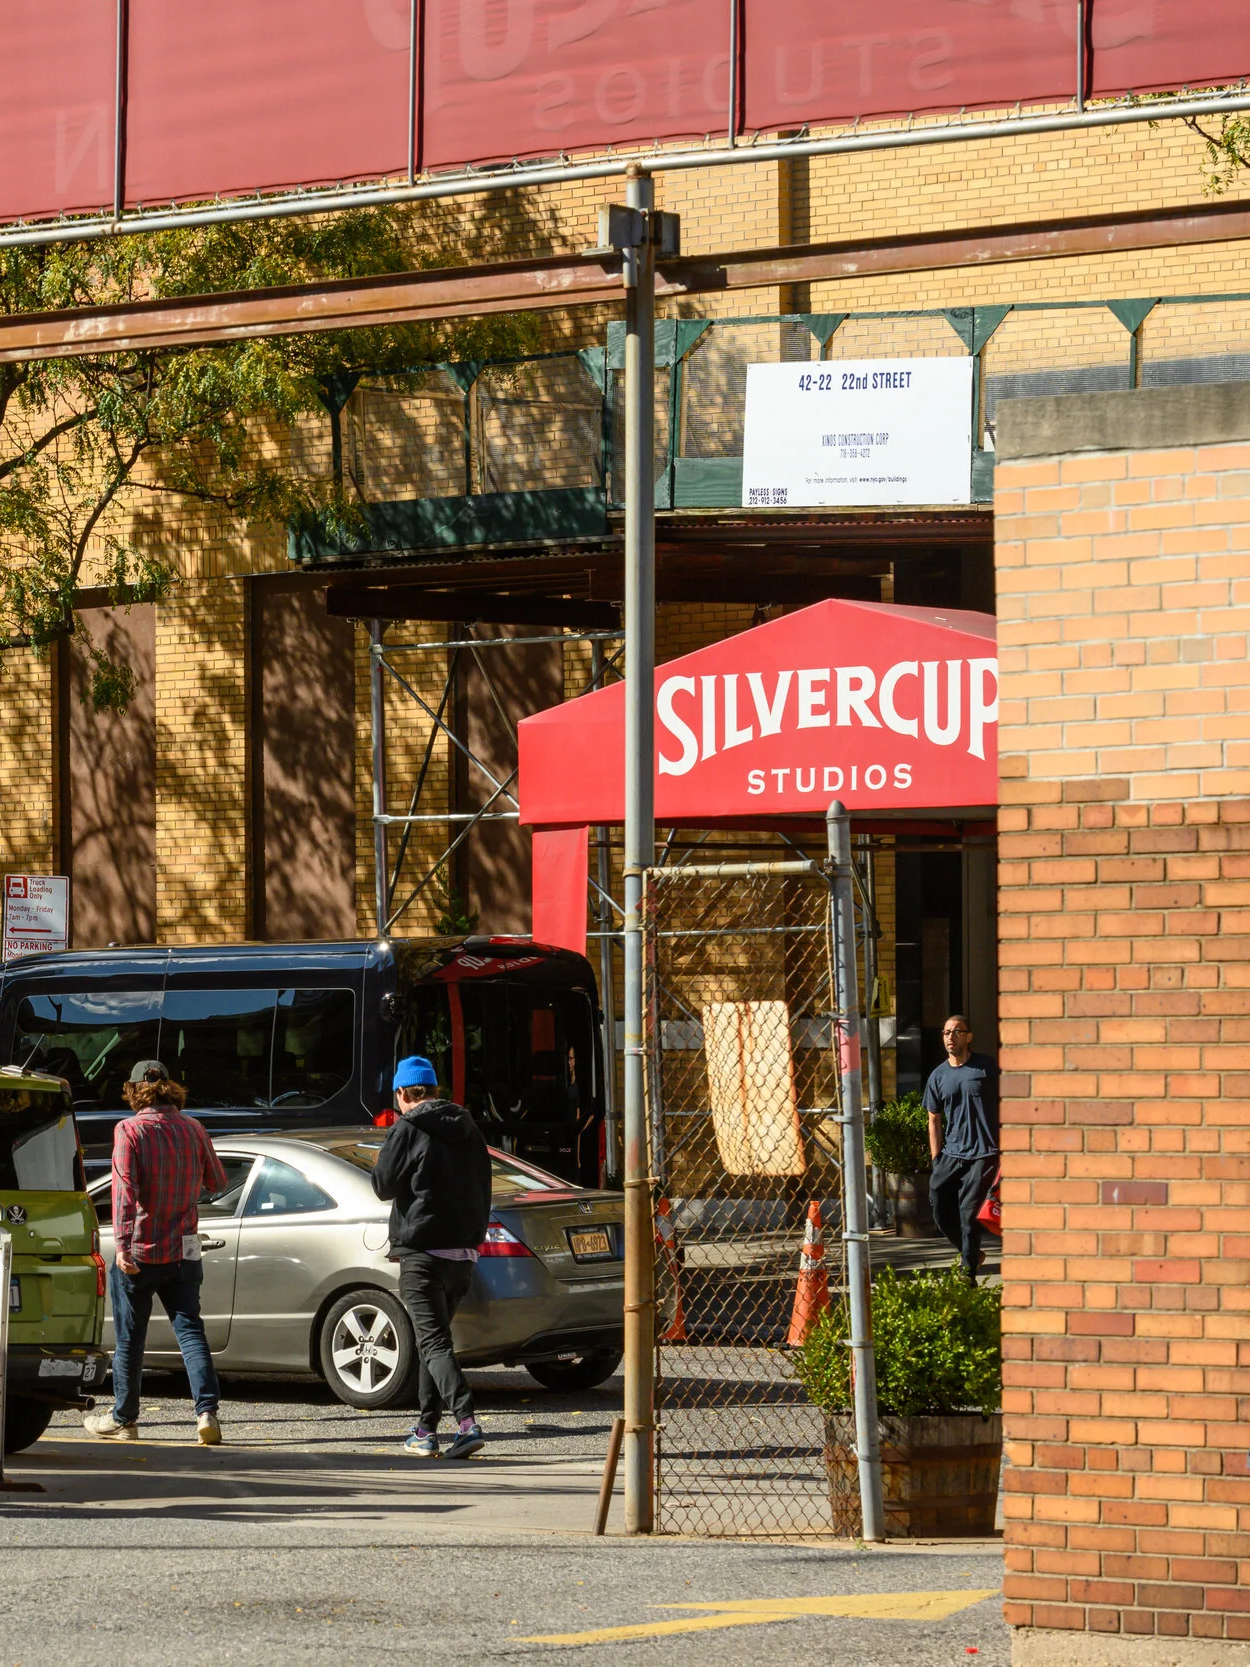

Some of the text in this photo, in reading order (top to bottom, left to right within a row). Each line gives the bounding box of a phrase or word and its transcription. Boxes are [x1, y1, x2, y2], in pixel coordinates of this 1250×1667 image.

[798, 372, 912, 391] 42-22 22nd STREET
[838, 433, 874, 446] CONSTRUCTION
[876, 432, 890, 445] CORP
[749, 487, 788, 496] PAYLESS SIGNS
[656, 657, 998, 776] SILVERCUP
[747, 763, 913, 795] STUDIOS
[30, 886, 53, 894] Loading
[8, 904, 30, 913] Monday
[7, 941, 53, 951] NO PARKING
[84, 1366, 95, 1378] 27
